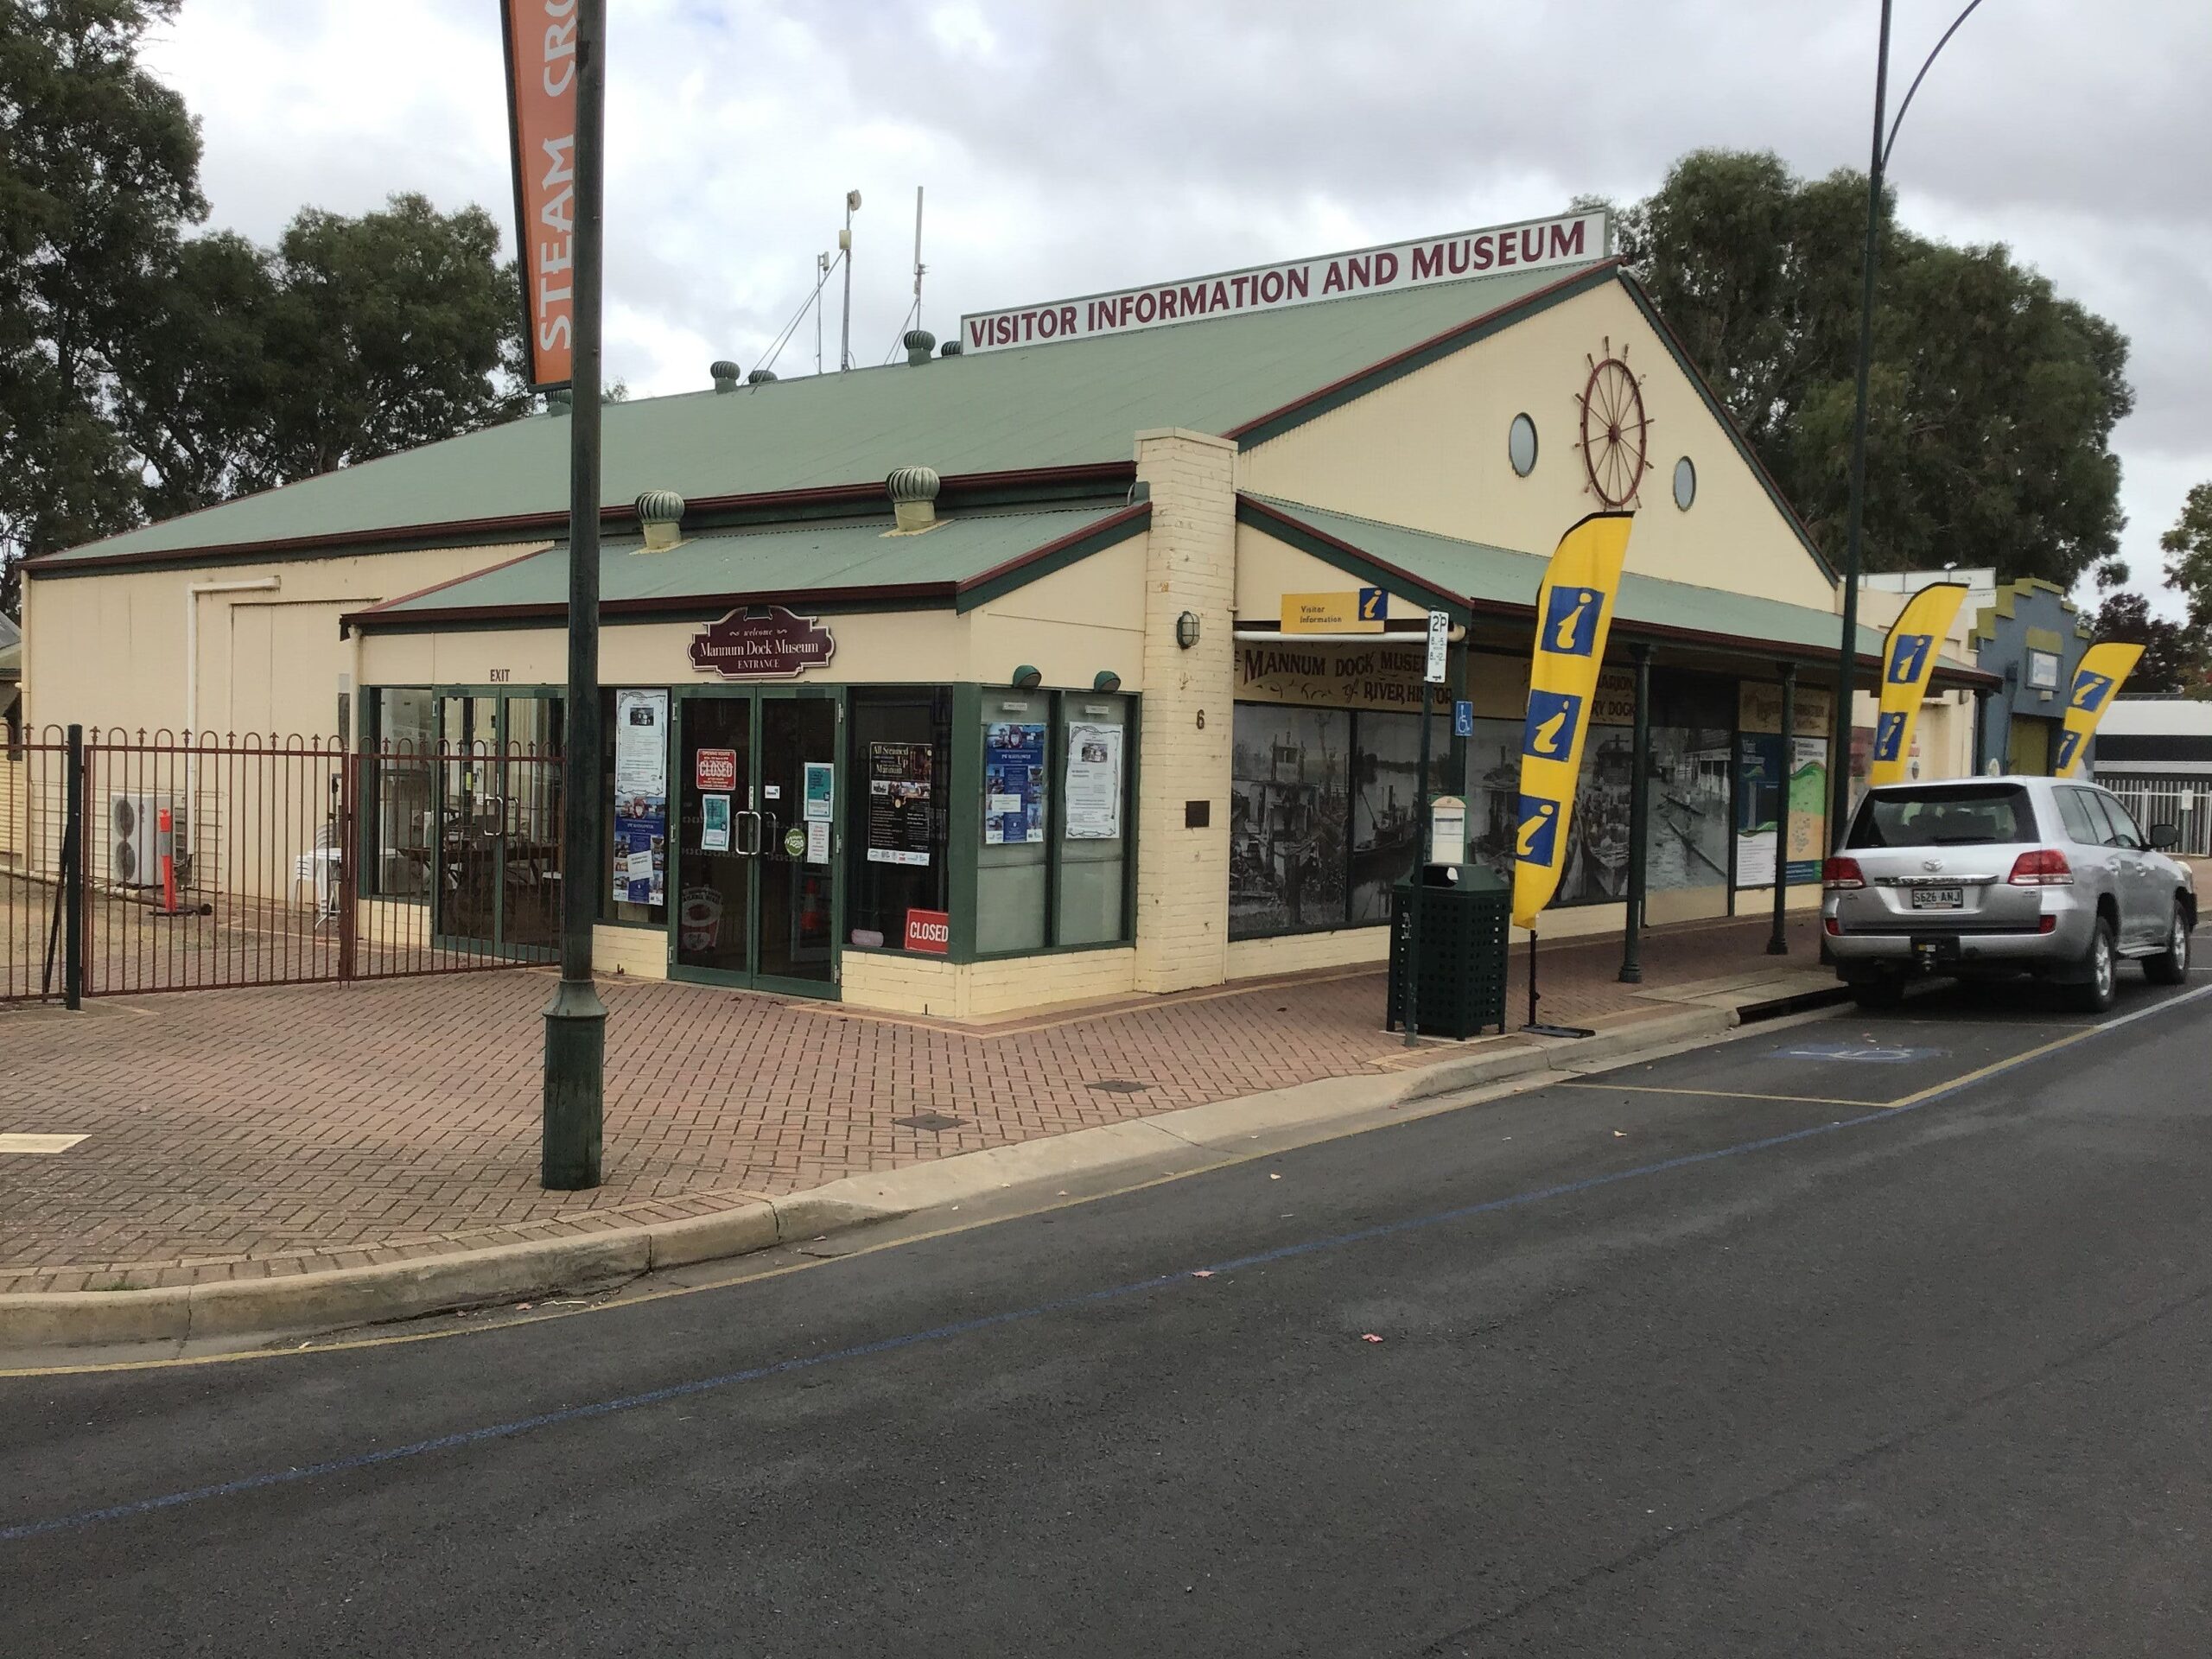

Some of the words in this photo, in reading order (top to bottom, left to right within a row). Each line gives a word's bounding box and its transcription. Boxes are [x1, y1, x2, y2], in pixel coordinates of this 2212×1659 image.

[540, 134, 574, 353] STEAM
[969, 306, 1077, 347] VISITOR
[1088, 266, 1309, 331] INFORMATION
[1322, 252, 1399, 295] AND
[1411, 219, 1586, 281] MUSEUM
[1300, 605, 1325, 613] Visitor
[743, 627, 773, 637] welcome
[1432, 615, 1447, 632] 2P
[700, 642, 744, 657] Mannum
[747, 639, 772, 656] Dock
[775, 639, 818, 655] Museum
[738, 659, 780, 670] ENTRANCE
[1244, 649, 1326, 685] MANNUM
[1334, 651, 1375, 677] DOCK
[1381, 651, 1426, 673] MUSE
[490, 669, 511, 683] EXIT
[1363, 681, 1405, 705] RIVER
[1408, 684, 1452, 704] HISTOR
[1196, 709, 1205, 730] 6
[699, 760, 734, 778] CLOSED
[910, 921, 949, 943] CLOSED
